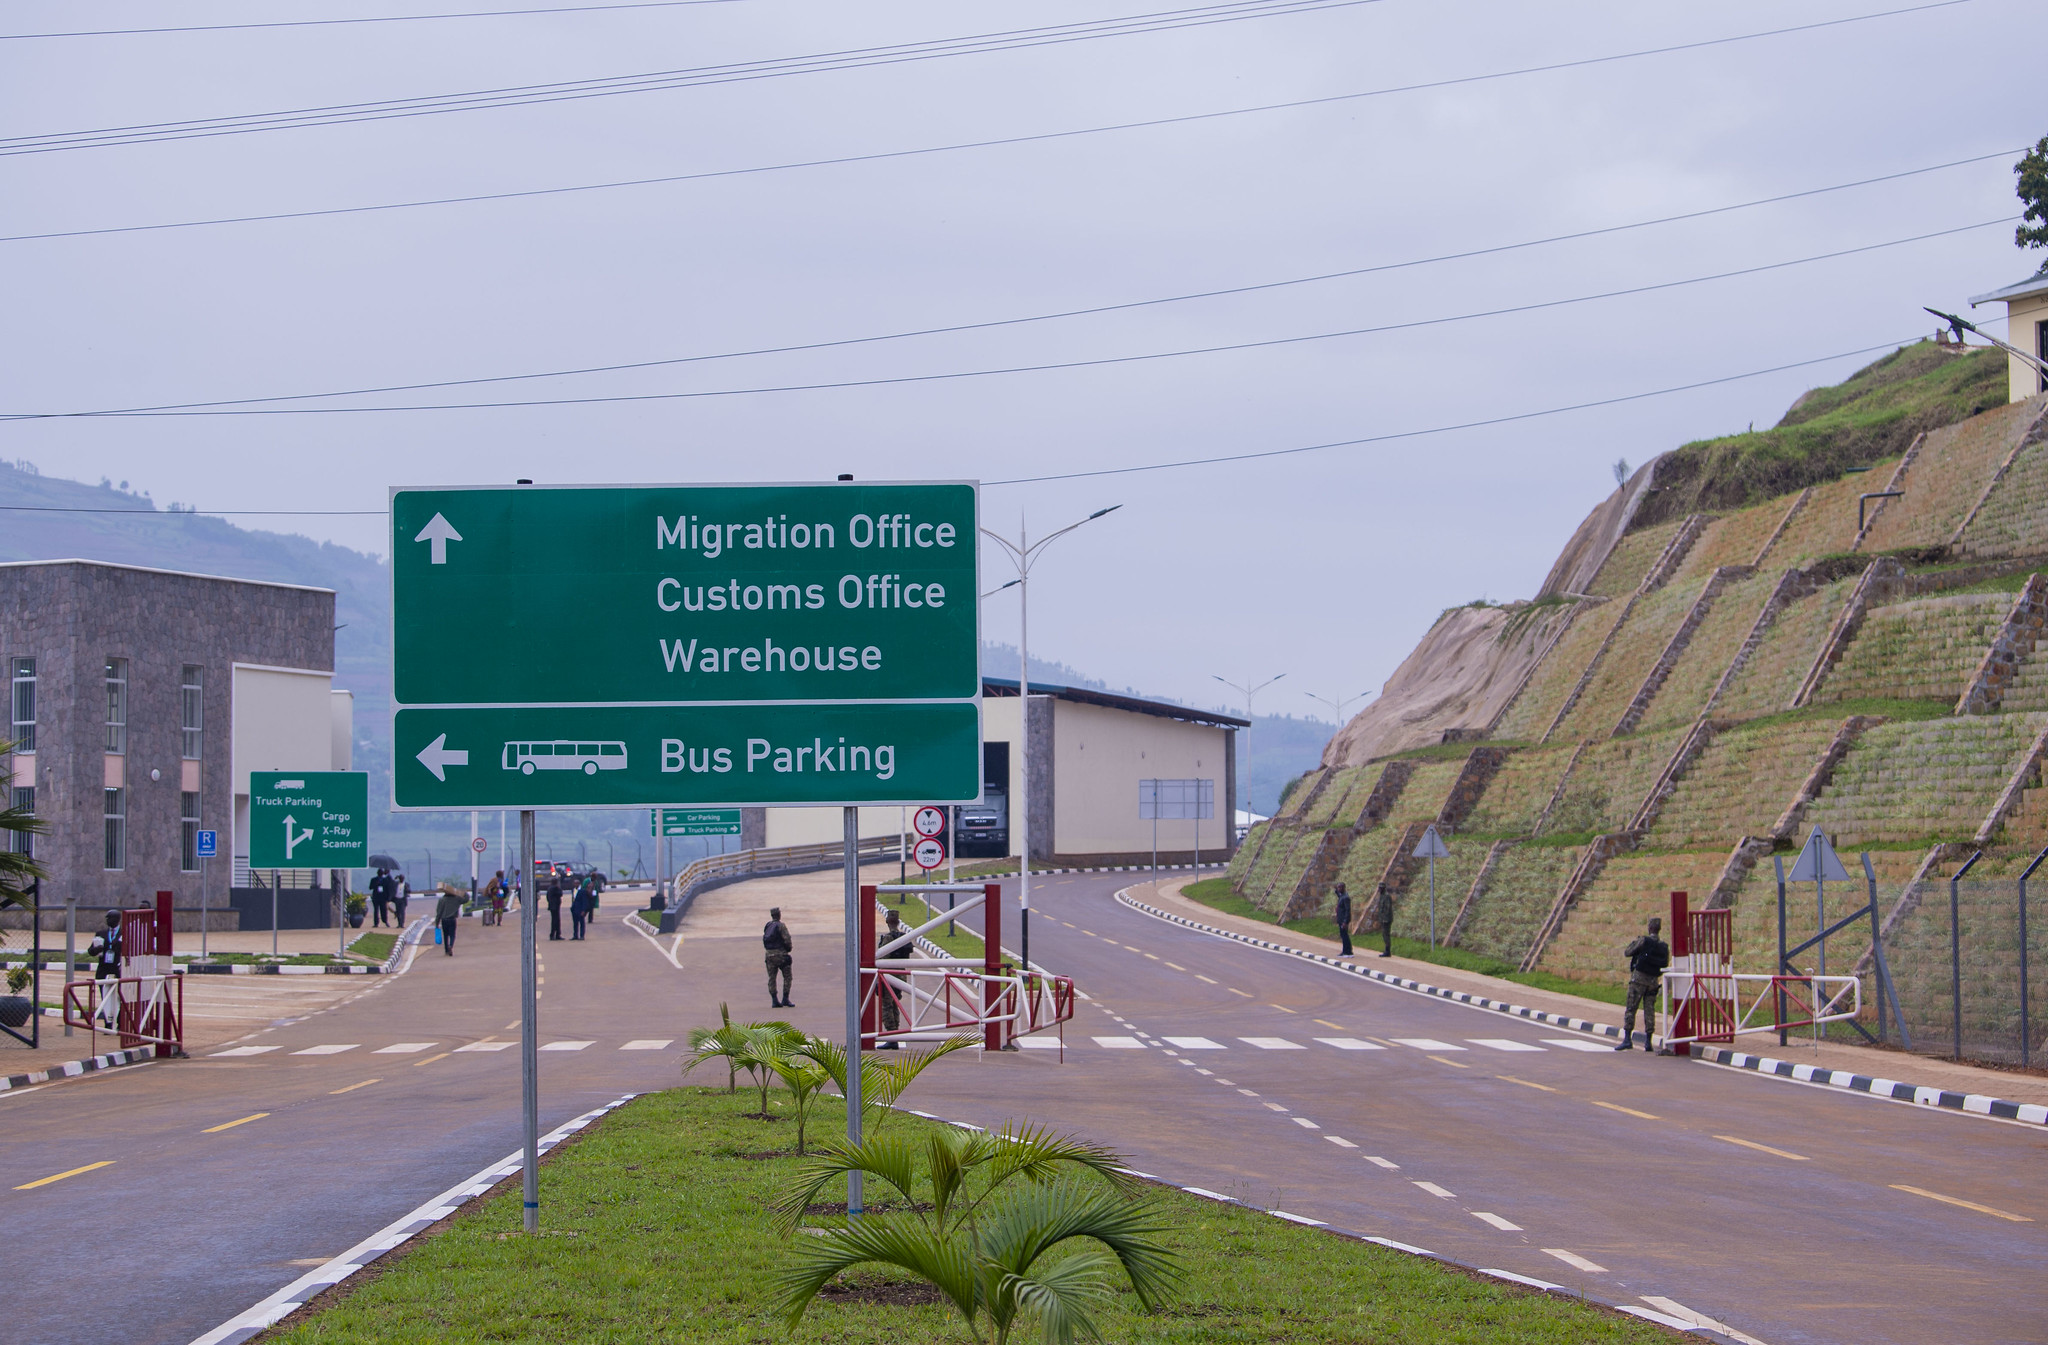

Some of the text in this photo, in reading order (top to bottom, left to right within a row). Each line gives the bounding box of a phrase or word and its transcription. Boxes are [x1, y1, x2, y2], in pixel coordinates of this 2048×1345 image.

[657, 514, 956, 558] Migration Office
[657, 574, 945, 612] Customs Office
[659, 638, 882, 672] Warehouse
[661, 737, 895, 780] Bus Parking
[256, 796, 322, 808] Truck Parking
[322, 812, 350, 823] Cargo
[322, 826, 351, 837] X-Ray
[705, 826, 728, 834] Parking
[203, 832, 211, 843] R
[322, 839, 362, 848] Scanner
